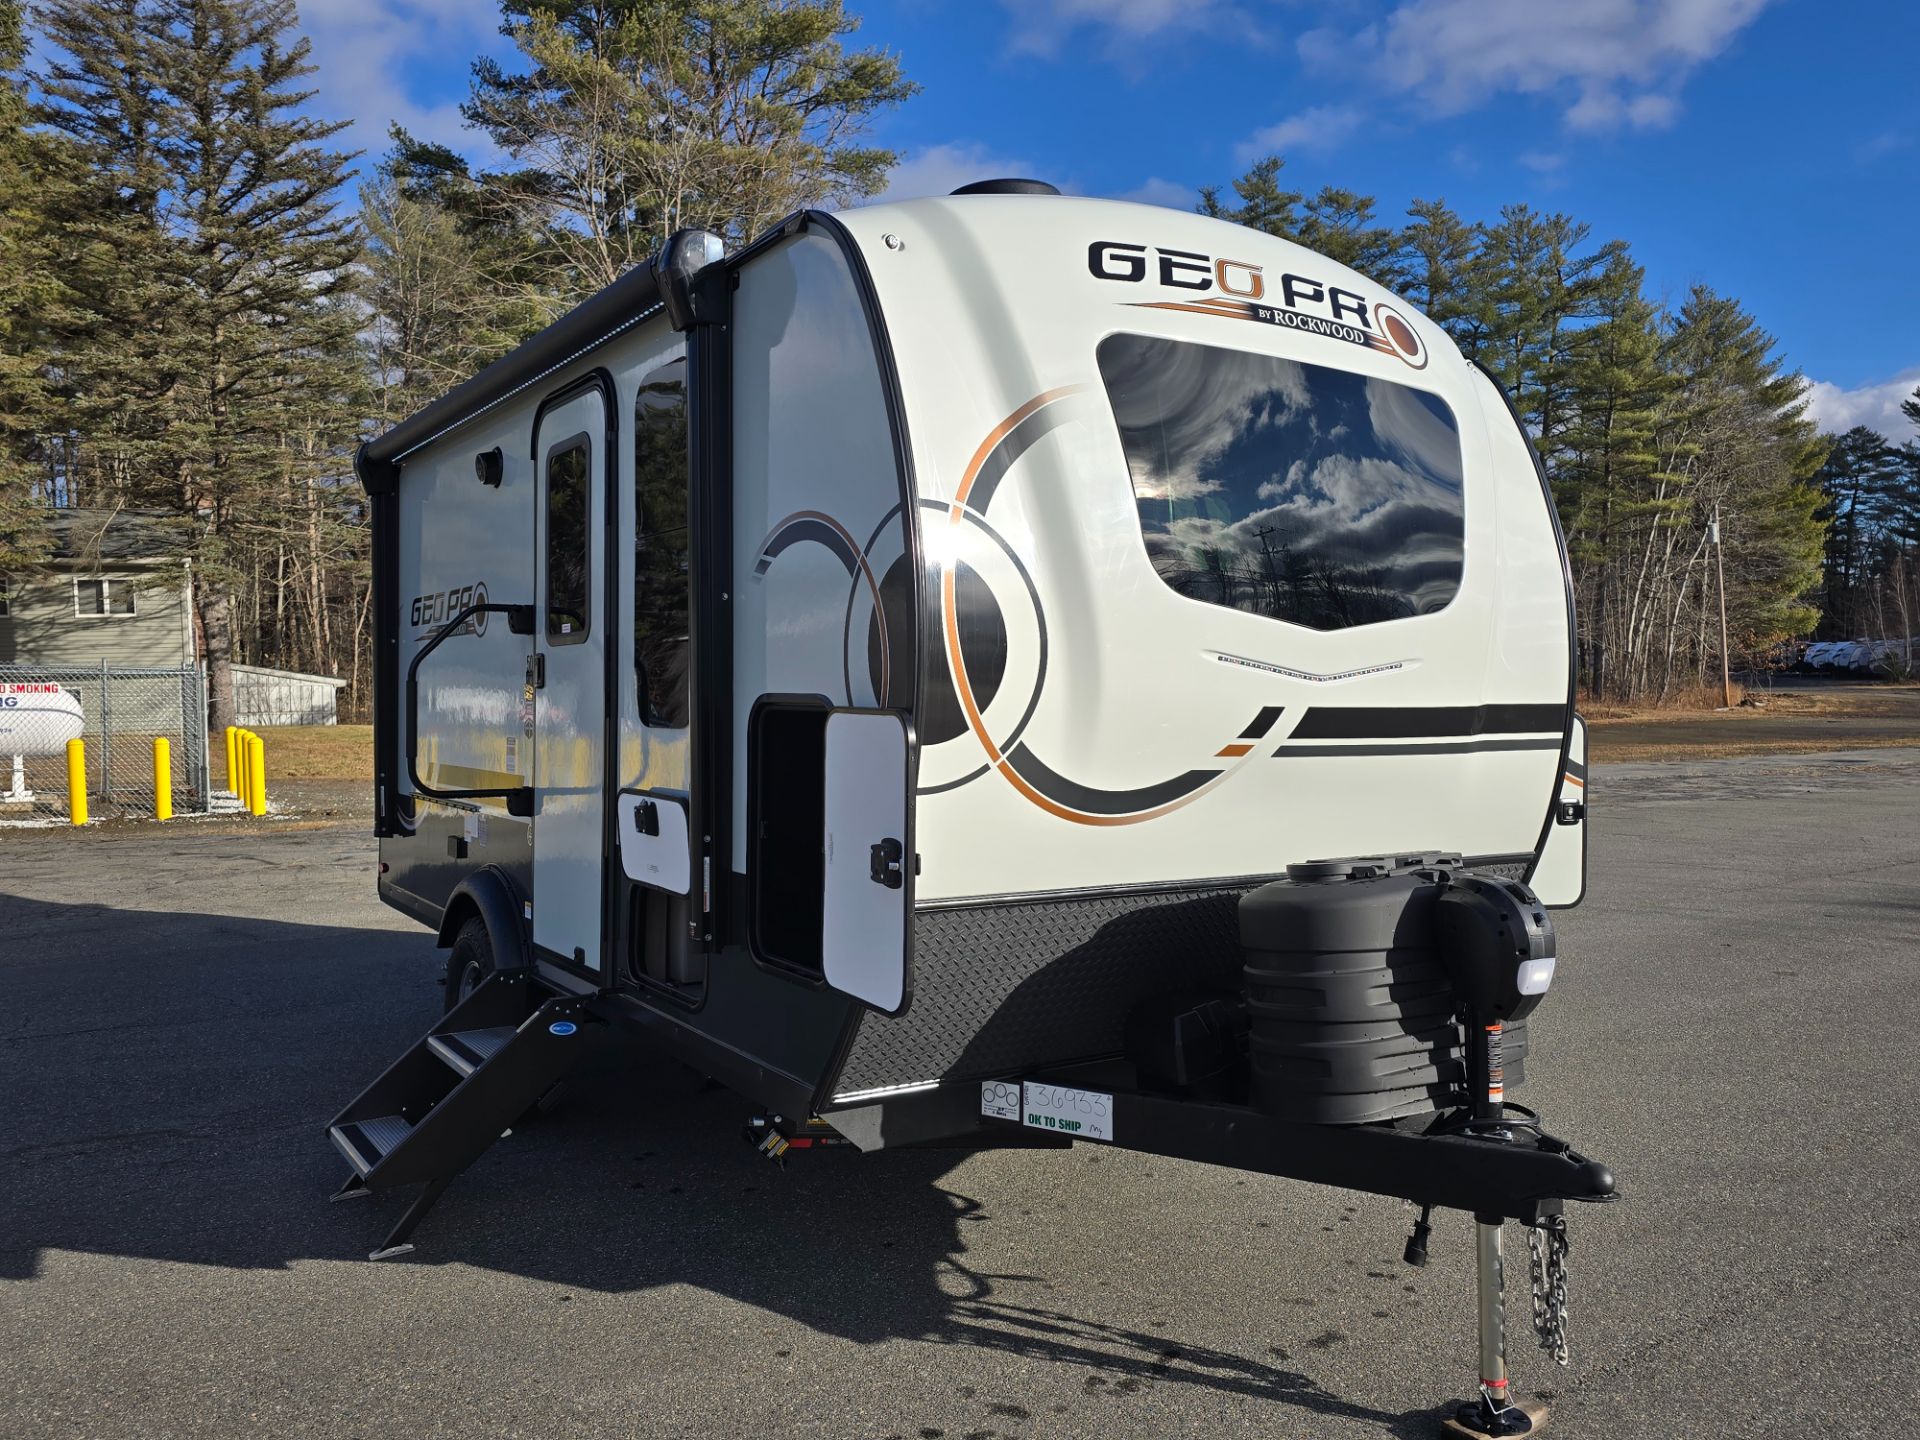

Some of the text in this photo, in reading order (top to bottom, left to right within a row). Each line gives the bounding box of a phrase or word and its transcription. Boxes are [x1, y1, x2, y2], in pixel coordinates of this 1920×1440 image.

[1088, 240, 1429, 370] GEO PRO
[1258, 308, 1365, 345] BY ROCKWOOD
[411, 592, 446, 627] GEO
[0, 696, 17, 707] G
[9, 684, 58, 693] SMOKING
[1028, 1113, 1082, 1132] OK TO SHIP
